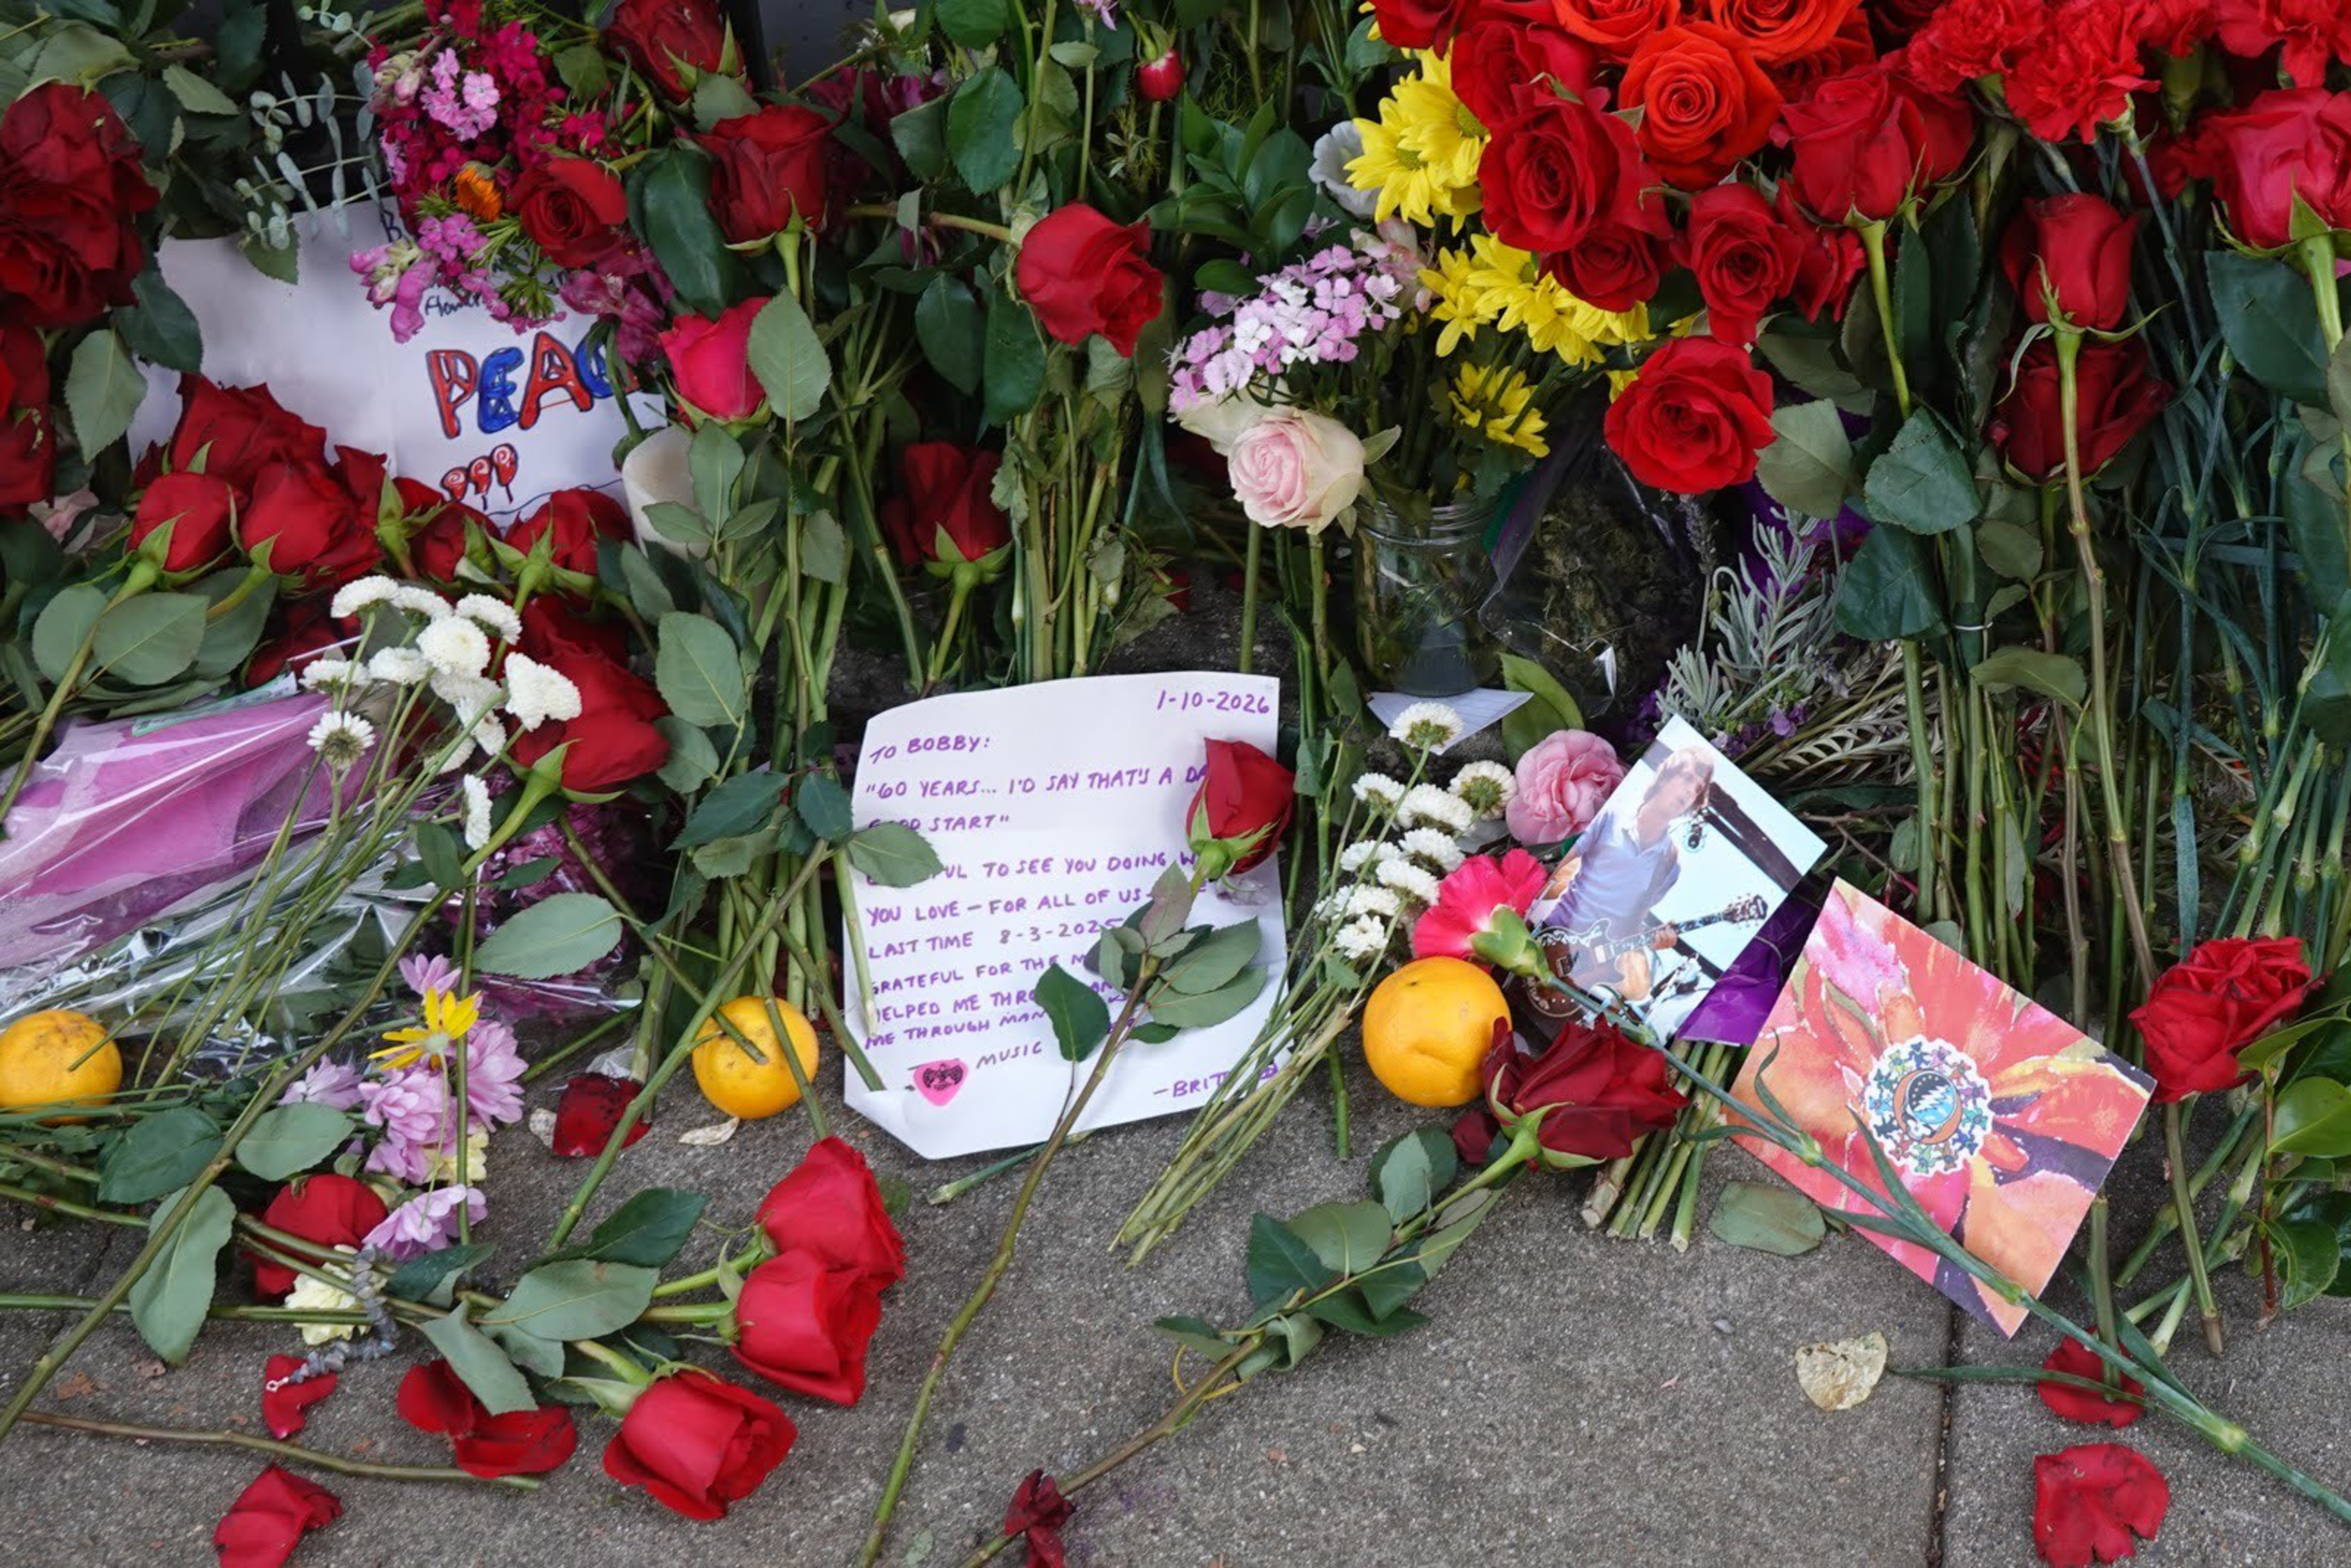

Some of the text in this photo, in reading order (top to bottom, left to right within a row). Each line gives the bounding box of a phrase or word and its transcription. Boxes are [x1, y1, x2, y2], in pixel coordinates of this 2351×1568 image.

[426, 331, 640, 440] PEAC
[1157, 690, 1270, 714] 1-10-2026
[869, 735, 990, 764] TO BOBBY:
[866, 764, 1207, 799] "60 YEARS... I'D SAY THAT'S A DA
[869, 814, 1009, 832] OD START"
[983, 862, 1009, 877] TO
[1015, 857, 1054, 874] SEE
[1065, 858, 1097, 874] YOU
[1107, 852, 1166, 872] DOING
[866, 906, 901, 927] YOU
[915, 901, 960, 921] LOVE
[989, 897, 1027, 915] FOR
[1037, 893, 1075, 910] ALL
[1084, 890, 1110, 905] OF
[868, 939, 918, 959] LAST
[926, 931, 974, 955] TIME
[976, 962, 1012, 978] FOR
[1020, 954, 1059, 970] THE
[953, 994, 980, 1013] ME
[990, 989, 1035, 1007] THRO
[864, 1010, 1046, 1049] ME THROUGH MAN
[976, 1041, 1043, 1070] MUSIC
